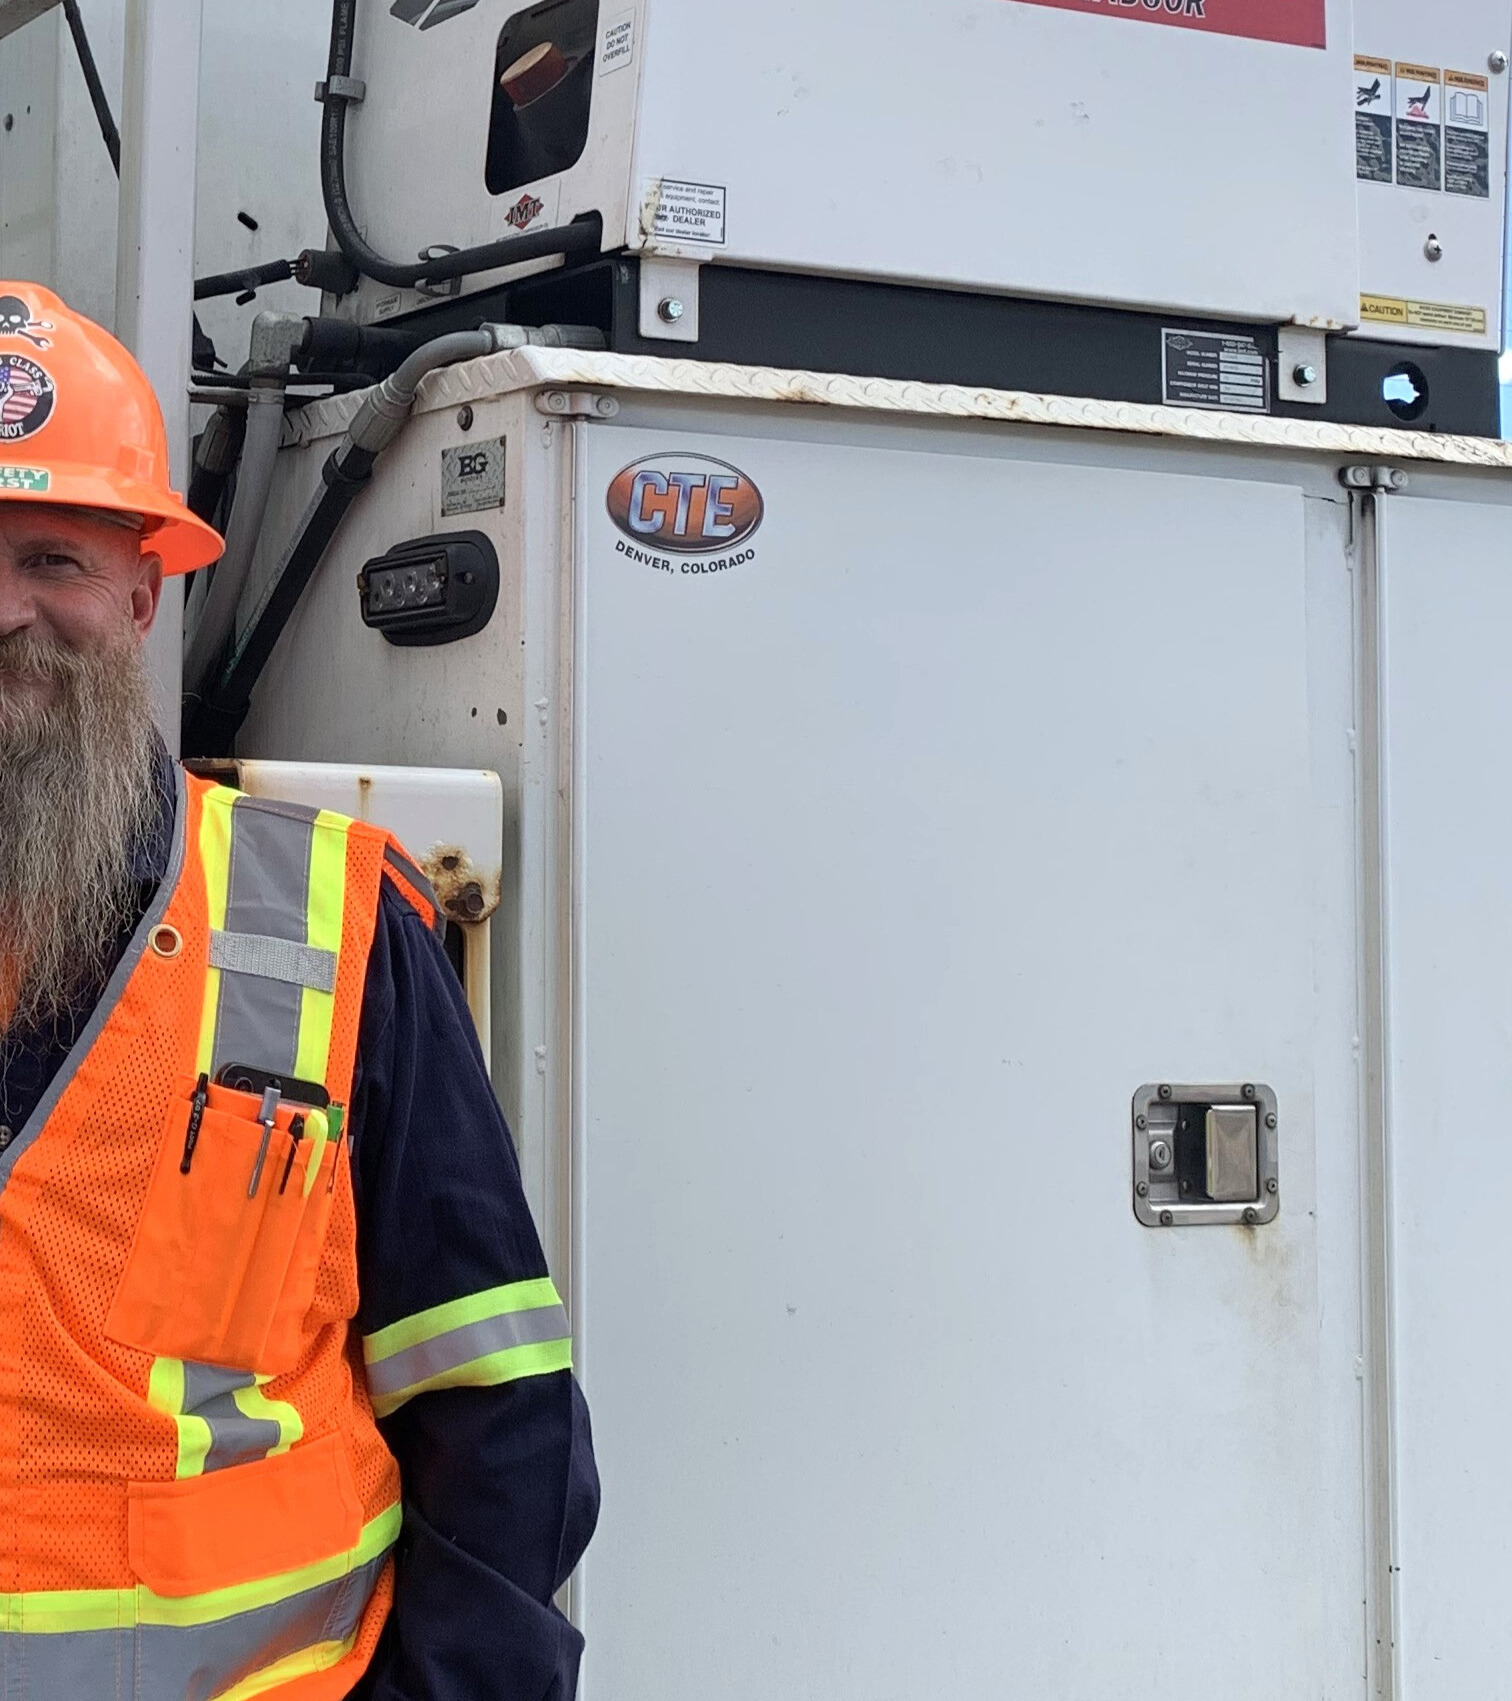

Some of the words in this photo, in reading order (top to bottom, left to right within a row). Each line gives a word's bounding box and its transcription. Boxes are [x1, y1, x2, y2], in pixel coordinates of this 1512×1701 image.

[605, 21, 631, 39] CAUTION
[606, 39, 615, 50] DO
[616, 33, 629, 45] NOT
[602, 44, 630, 63] OVERFILL
[508, 196, 541, 227] IMT
[668, 205, 721, 219] AUTHORIZED
[672, 215, 706, 226] DEALER
[1368, 304, 1404, 316] CAUTION
[9, 356, 43, 380] CLASS
[458, 452, 489, 477] BG
[627, 470, 740, 537] CTE
[615, 540, 675, 575] DENVER,
[681, 548, 755, 574] COLORADO
